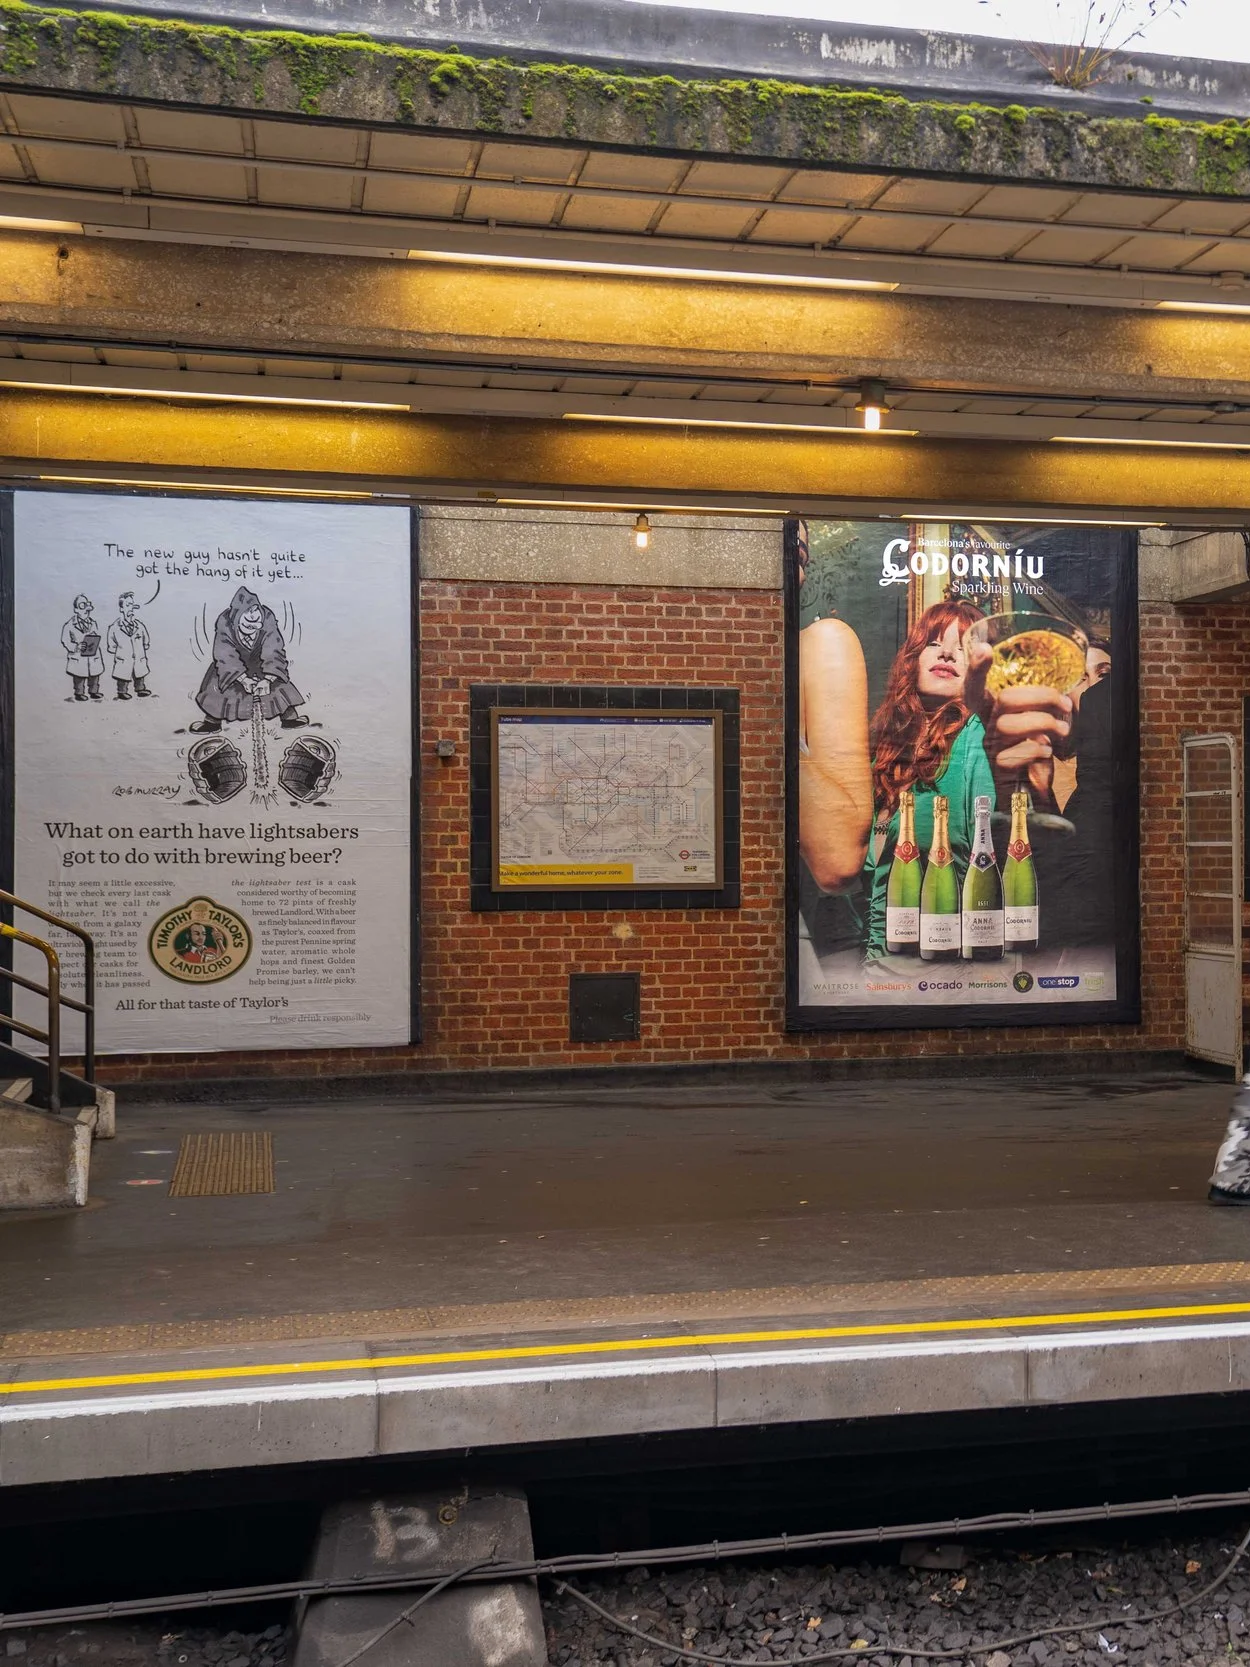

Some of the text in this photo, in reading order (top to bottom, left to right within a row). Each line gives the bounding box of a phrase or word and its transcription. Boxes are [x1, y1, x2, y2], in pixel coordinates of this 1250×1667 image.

[918, 537, 1011, 549] Barcelona's favourite
[104, 543, 306, 564] The new guy hasn't quite
[136, 562, 303, 581] got the hang of it yet...
[952, 580, 1044, 596] Sparkling Wine
[44, 822, 359, 843] What on earth have lightsabers
[62, 848, 342, 867] got to do with brewing beer?
[319, 889, 357, 897] becoming
[292, 899, 313, 907] pints
[328, 899, 356, 907] freshly
[267, 919, 287, 927] finely
[157, 910, 246, 949] TIMOTHY TAYLOR'S
[275, 939, 299, 947] purest
[332, 938, 356, 946] spring
[169, 955, 232, 975] LANDLORD
[260, 958, 280, 966] hops
[248, 978, 266, 986] help
[267, 978, 290, 986] being
[291, 978, 307, 986] just
[929, 980, 962, 990] ocado
[968, 980, 1008, 989] Morrisons
[1057, 978, 1075, 986] stop
[115, 997, 289, 1011] All for that taste of Taylor's
[269, 1012, 373, 1023] Please drink responsibly
